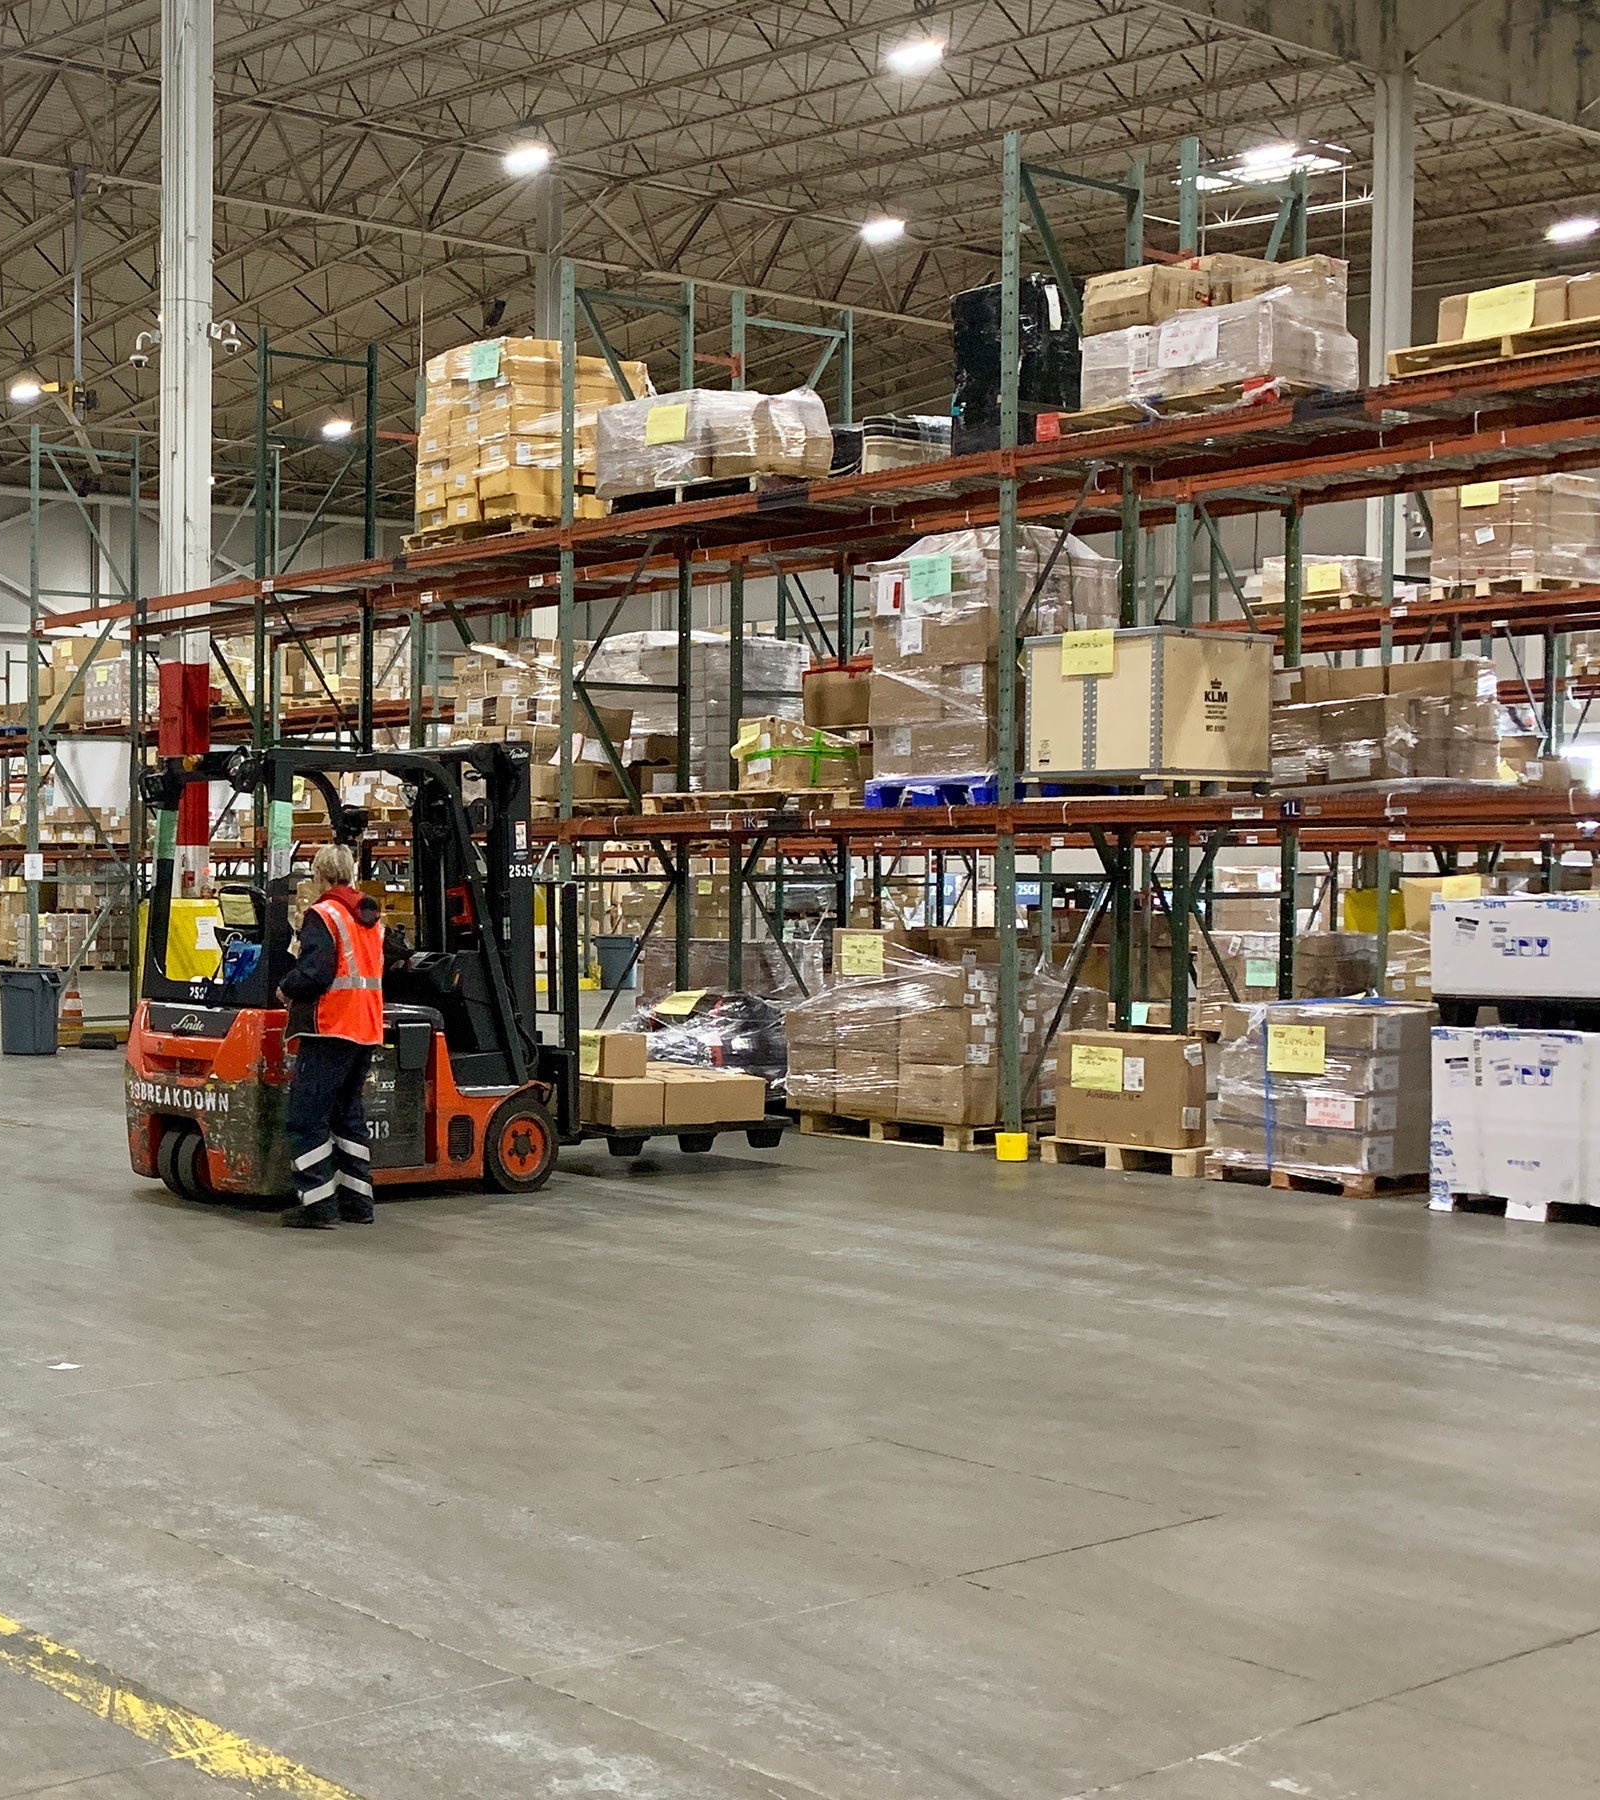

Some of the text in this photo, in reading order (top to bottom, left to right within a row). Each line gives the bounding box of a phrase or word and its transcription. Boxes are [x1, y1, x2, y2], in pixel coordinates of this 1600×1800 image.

[1204, 690, 1228, 703] KLM
[1283, 801, 1300, 816] 1L
[742, 816, 756, 829] 1K
[508, 864, 533, 878] 2535
[1017, 884, 1040, 896] 2SCH
[171, 1013, 206, 1032] Linde
